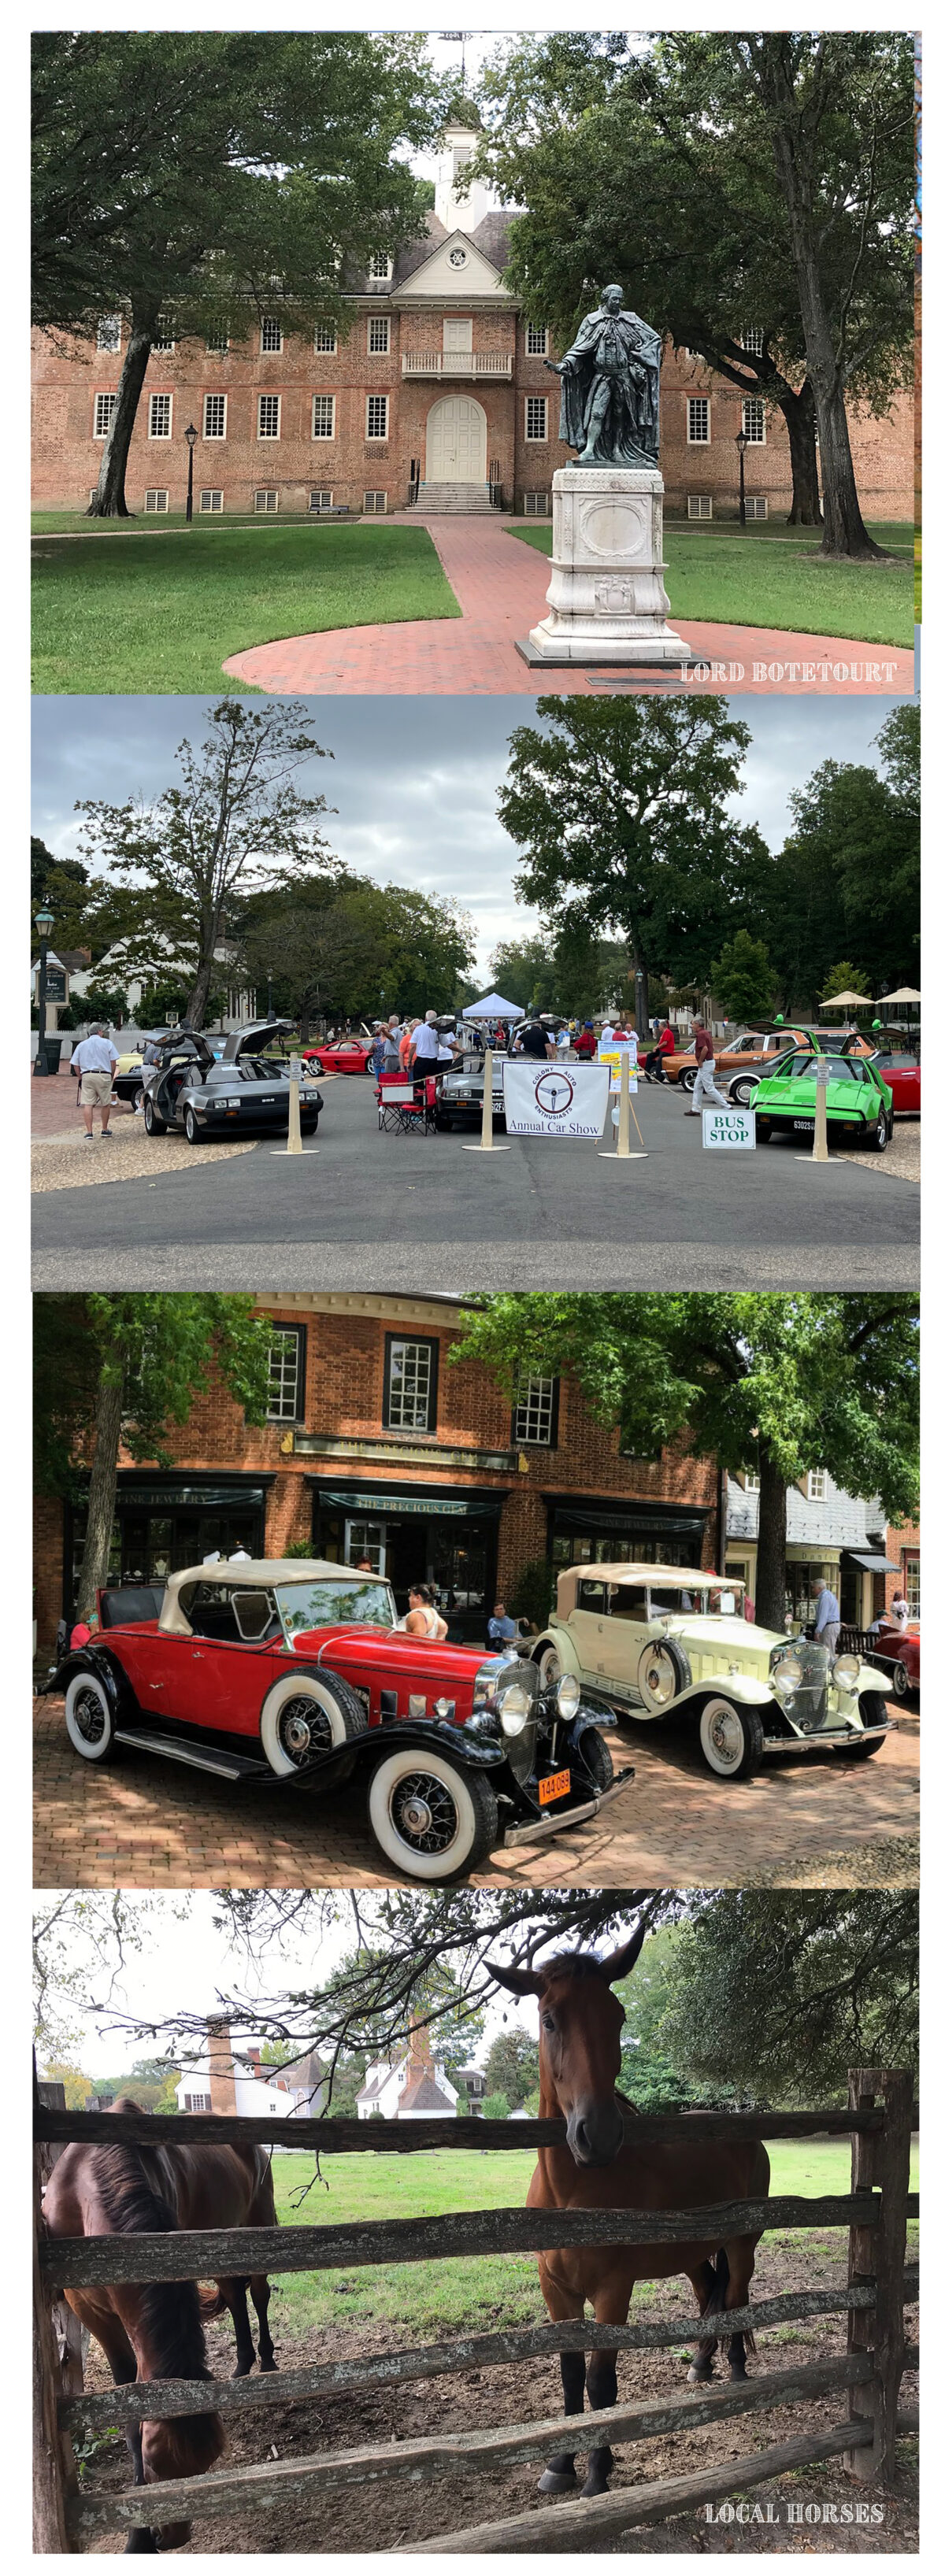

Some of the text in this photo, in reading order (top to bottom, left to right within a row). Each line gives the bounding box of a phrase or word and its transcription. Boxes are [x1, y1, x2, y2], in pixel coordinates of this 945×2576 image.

[532, 1067, 577, 1086] COLONY AUTO
[535, 1105, 573, 1120] ENTHUSIASTS
[510, 1120, 600, 1134] Annual Car Show
[714, 1116, 744, 1128] BUS
[710, 1130, 749, 1142] STOP
[339, 1441, 478, 1464] THE PRECIOUS GEM
[358, 1498, 378, 1509] THE
[383, 1501, 439, 1513] PRECIOUS
